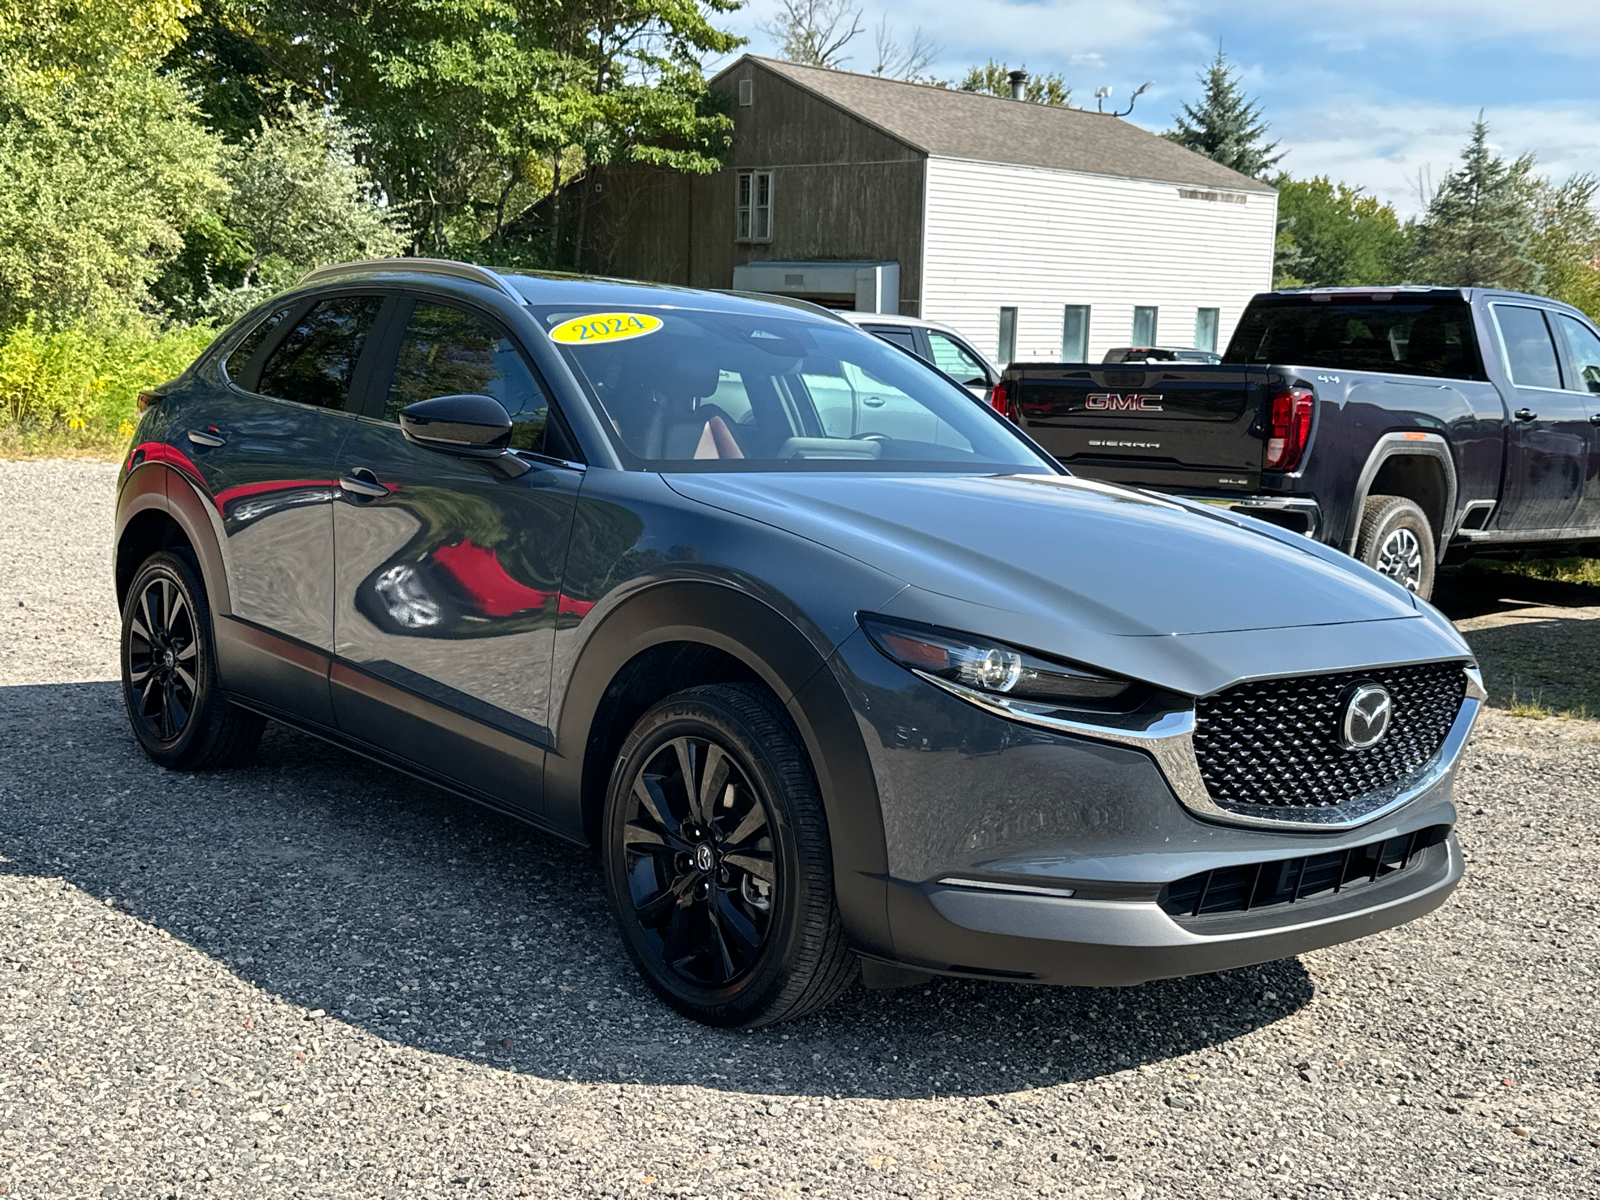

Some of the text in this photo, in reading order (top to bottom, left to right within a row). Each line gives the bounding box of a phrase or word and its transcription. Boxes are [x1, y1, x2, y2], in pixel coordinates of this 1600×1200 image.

[572, 315, 646, 341] 2024
[1085, 392, 1164, 411] GMC
[1088, 440, 1160, 448] SIERRA
